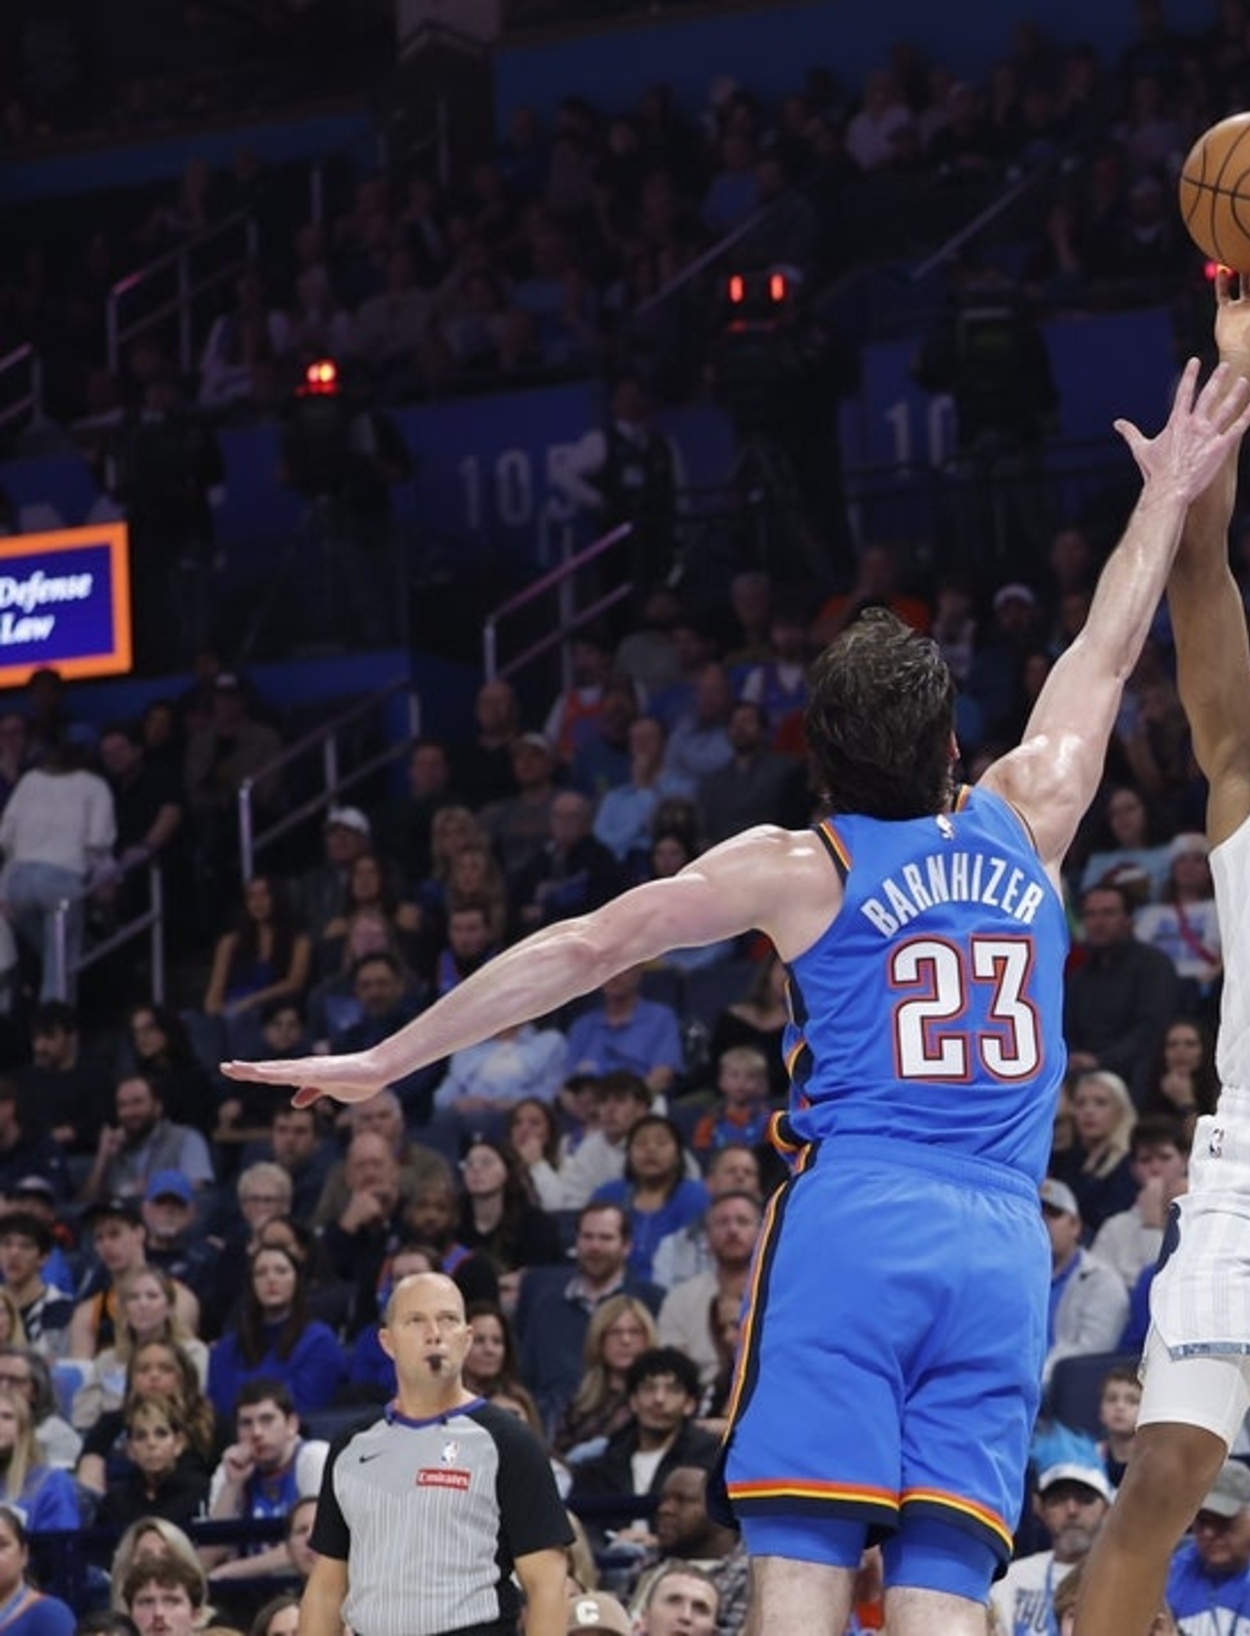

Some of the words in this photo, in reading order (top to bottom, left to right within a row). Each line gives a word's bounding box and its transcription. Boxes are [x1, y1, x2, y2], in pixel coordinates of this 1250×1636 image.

[0, 612, 56, 645] Law
[860, 853, 1043, 938] BARNHIZER
[889, 933, 1044, 1084] 23
